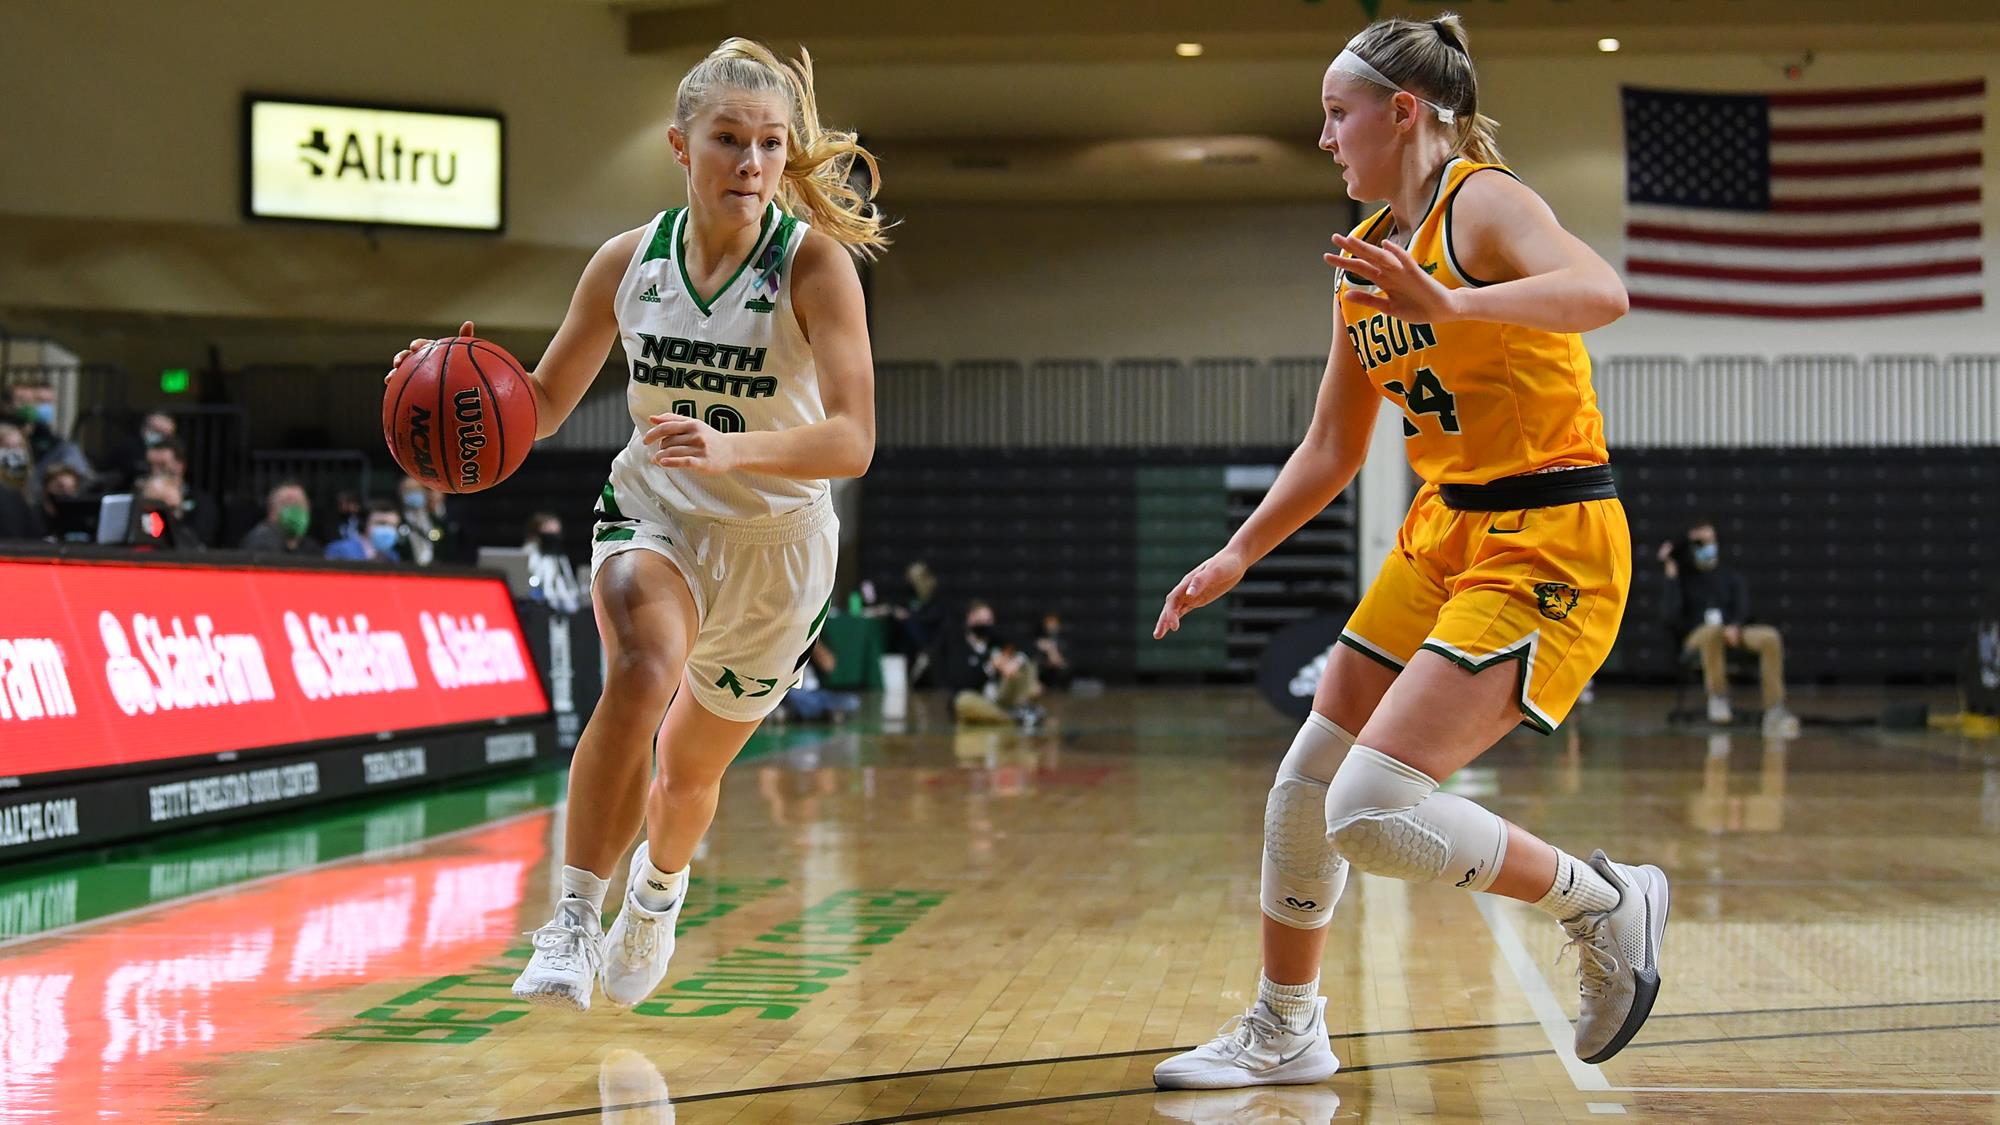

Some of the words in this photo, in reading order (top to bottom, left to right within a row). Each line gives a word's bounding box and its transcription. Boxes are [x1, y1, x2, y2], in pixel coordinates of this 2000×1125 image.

[335, 132, 457, 187] Altru
[633, 359, 778, 398] DAKOTA
[637, 332, 767, 372] NORTH
[453, 387, 488, 488] Wilson
[632, 948, 873, 1021] SIOUX
